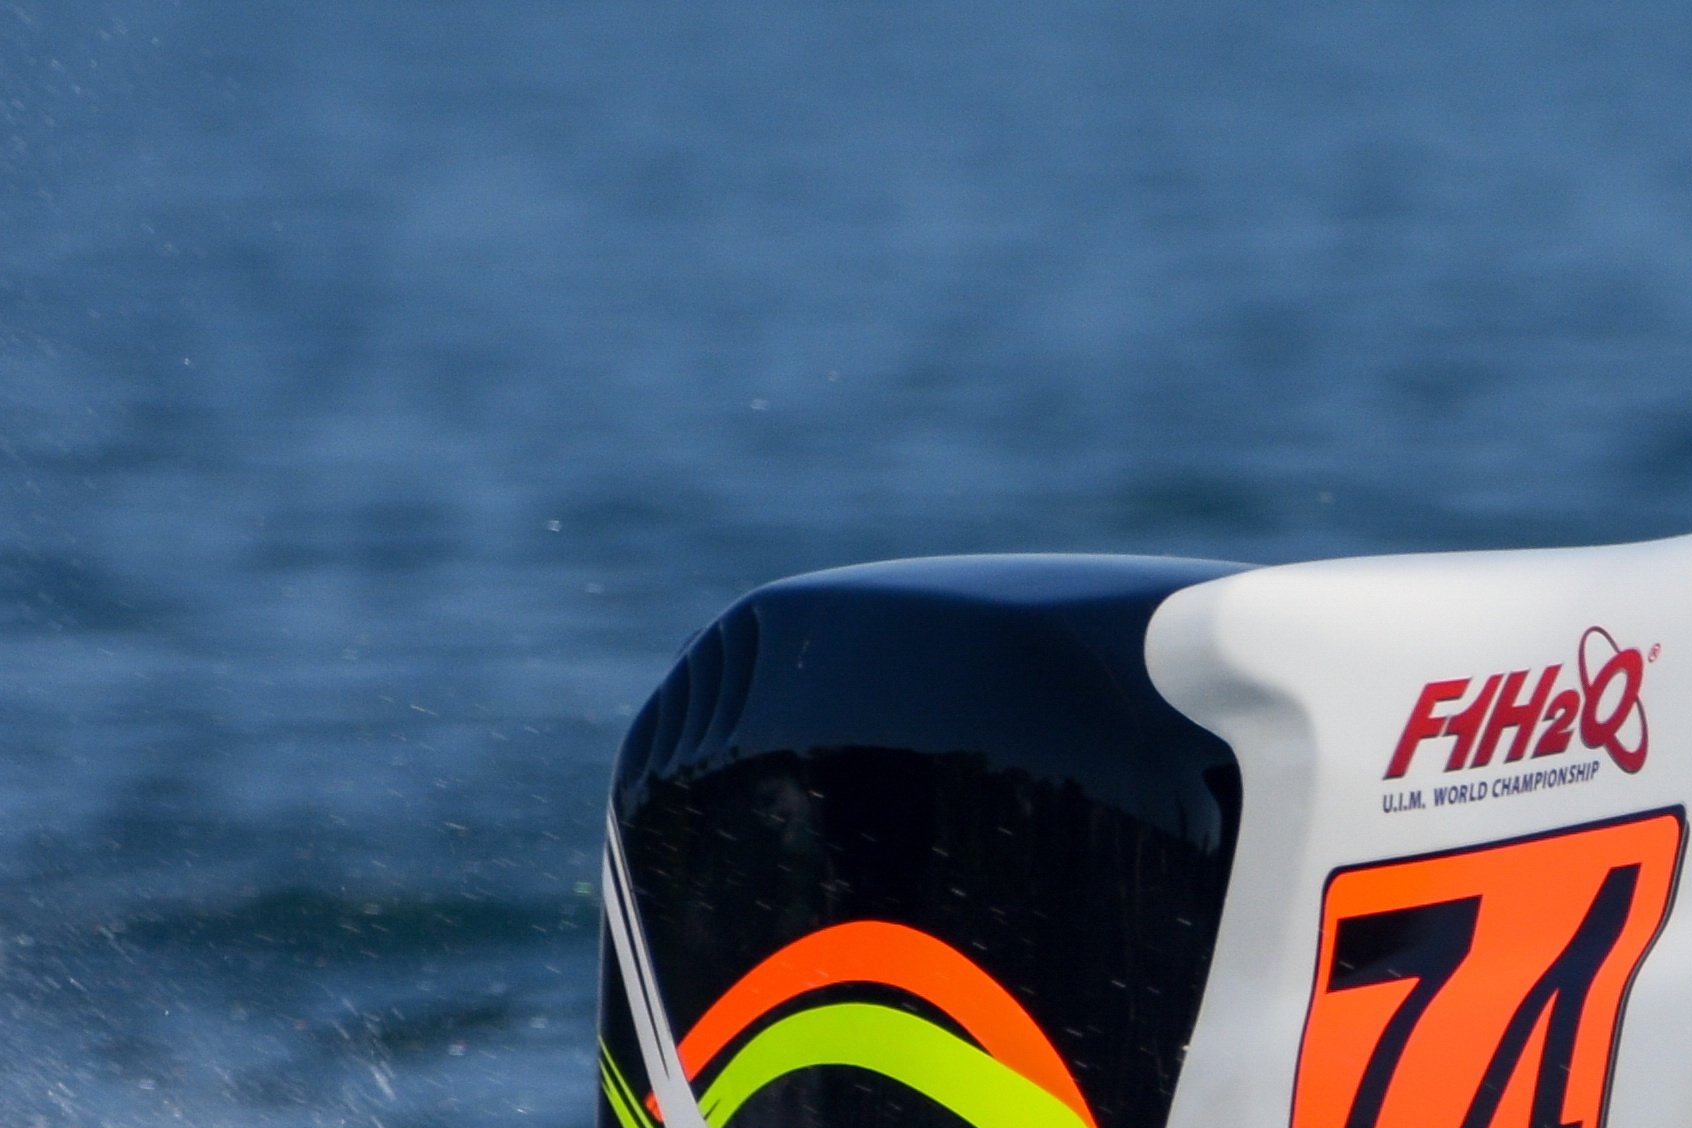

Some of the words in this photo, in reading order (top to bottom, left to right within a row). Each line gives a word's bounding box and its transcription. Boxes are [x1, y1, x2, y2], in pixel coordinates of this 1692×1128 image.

[1382, 791, 1427, 814] U.I.M.
[1434, 781, 1489, 808] WORLD
[1492, 760, 1600, 799] CHAMPIONSHIP
